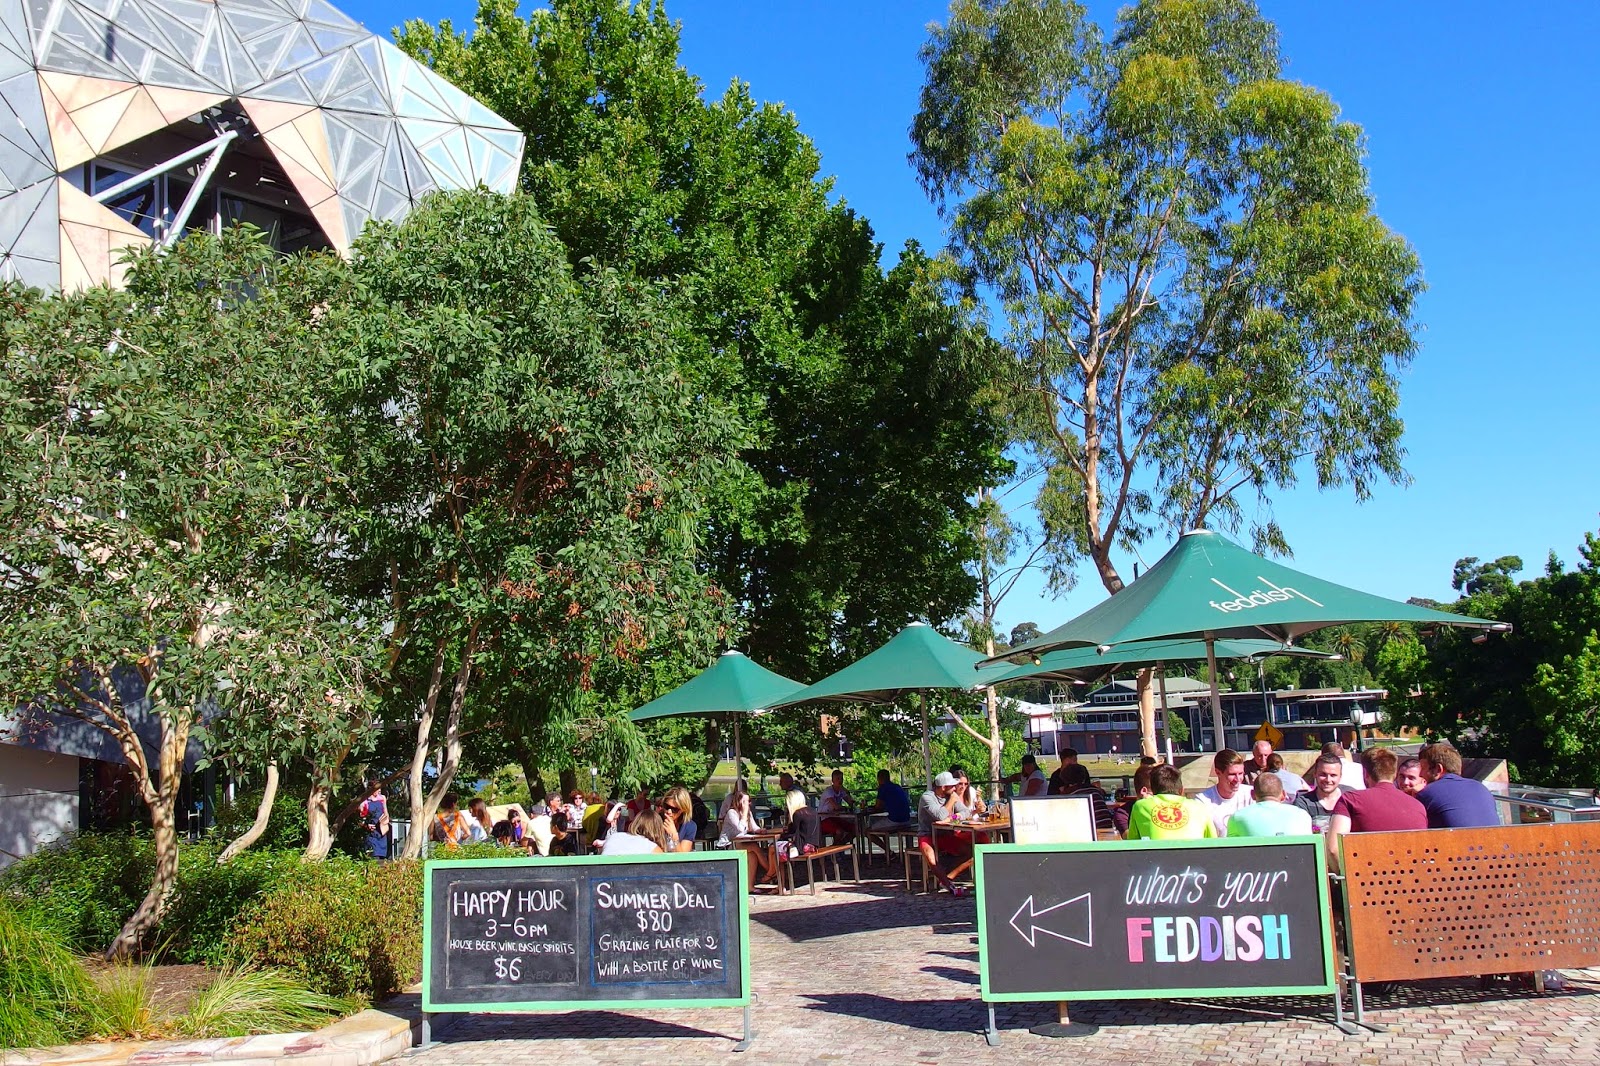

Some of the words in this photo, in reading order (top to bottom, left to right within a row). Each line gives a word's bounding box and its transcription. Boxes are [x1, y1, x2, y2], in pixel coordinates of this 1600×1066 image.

[1209, 575, 1324, 613] feddish
[596, 882, 671, 910] SUMMER
[673, 882, 715, 909] DEAL
[1125, 865, 1208, 905] what's
[1217, 870, 1288, 908] your
[453, 888, 512, 918] HAPPY
[518, 888, 567, 912] HOUR
[636, 909, 673, 932] $80
[449, 939, 474, 950] HOUSE
[542, 941, 576, 955] SPIRITS
[598, 933, 650, 952] GRAZING
[655, 936, 681, 949] PLATE
[683, 937, 702, 949] FOR
[705, 935, 718, 950] 2
[1126, 914, 1291, 962] FEDDISH
[494, 954, 522, 981] $6
[597, 960, 619, 977] WITH
[622, 964, 630, 974] A
[633, 960, 669, 973] BOTTLE
[672, 958, 686, 970] OF
[691, 957, 724, 970] WINE
